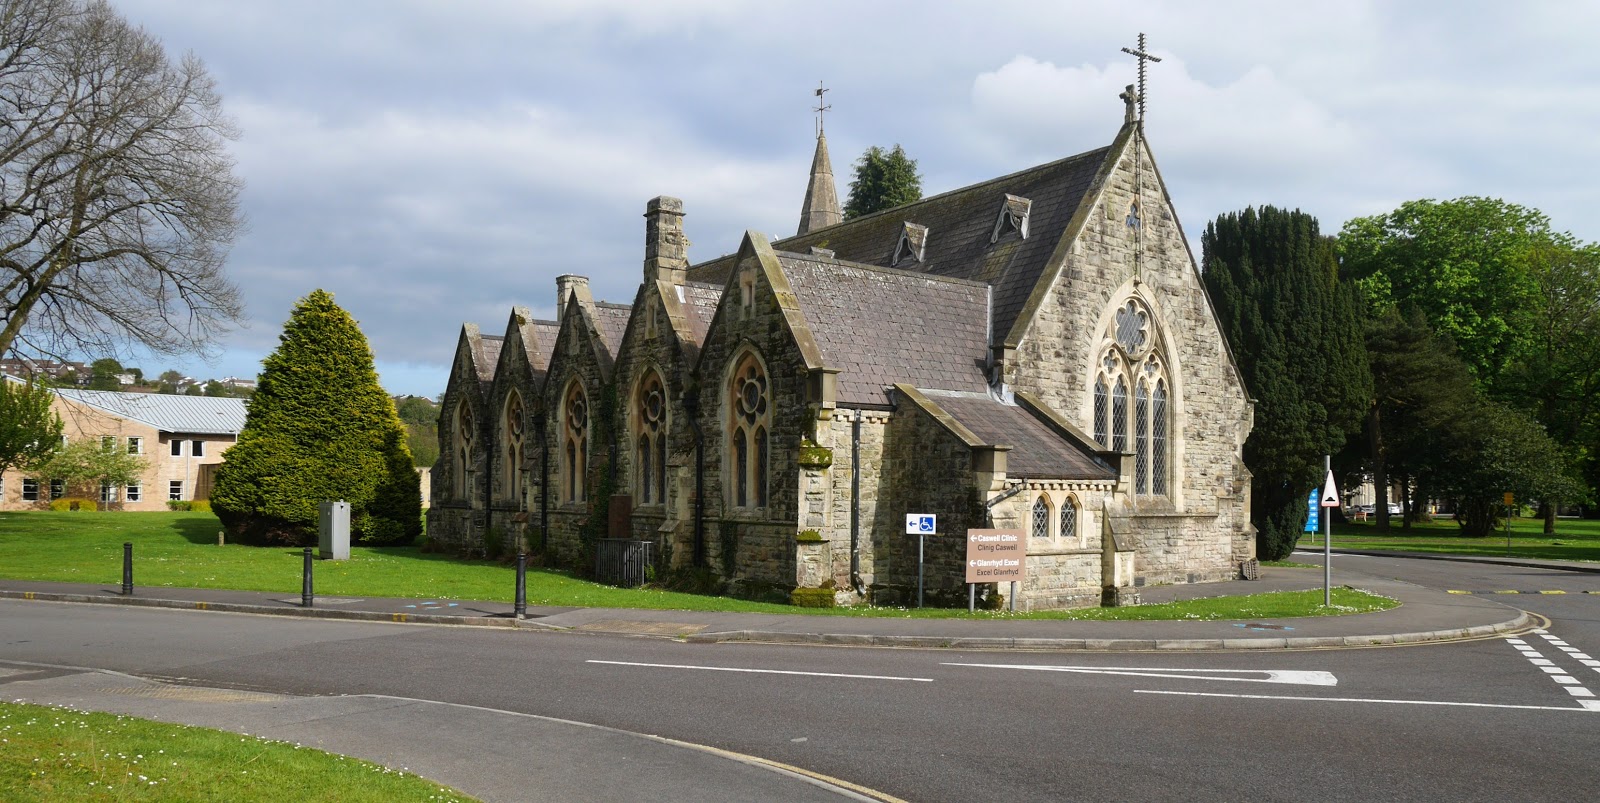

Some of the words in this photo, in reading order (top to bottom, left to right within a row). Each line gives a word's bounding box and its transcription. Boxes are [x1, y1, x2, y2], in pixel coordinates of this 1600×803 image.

[977, 534, 1000, 542] Caswell
[1001, 534, 1018, 542] Clinic
[977, 544, 994, 552] Clinig
[977, 559, 1003, 568] Glanrhyd
[993, 569, 1019, 577] Glanrhyd
